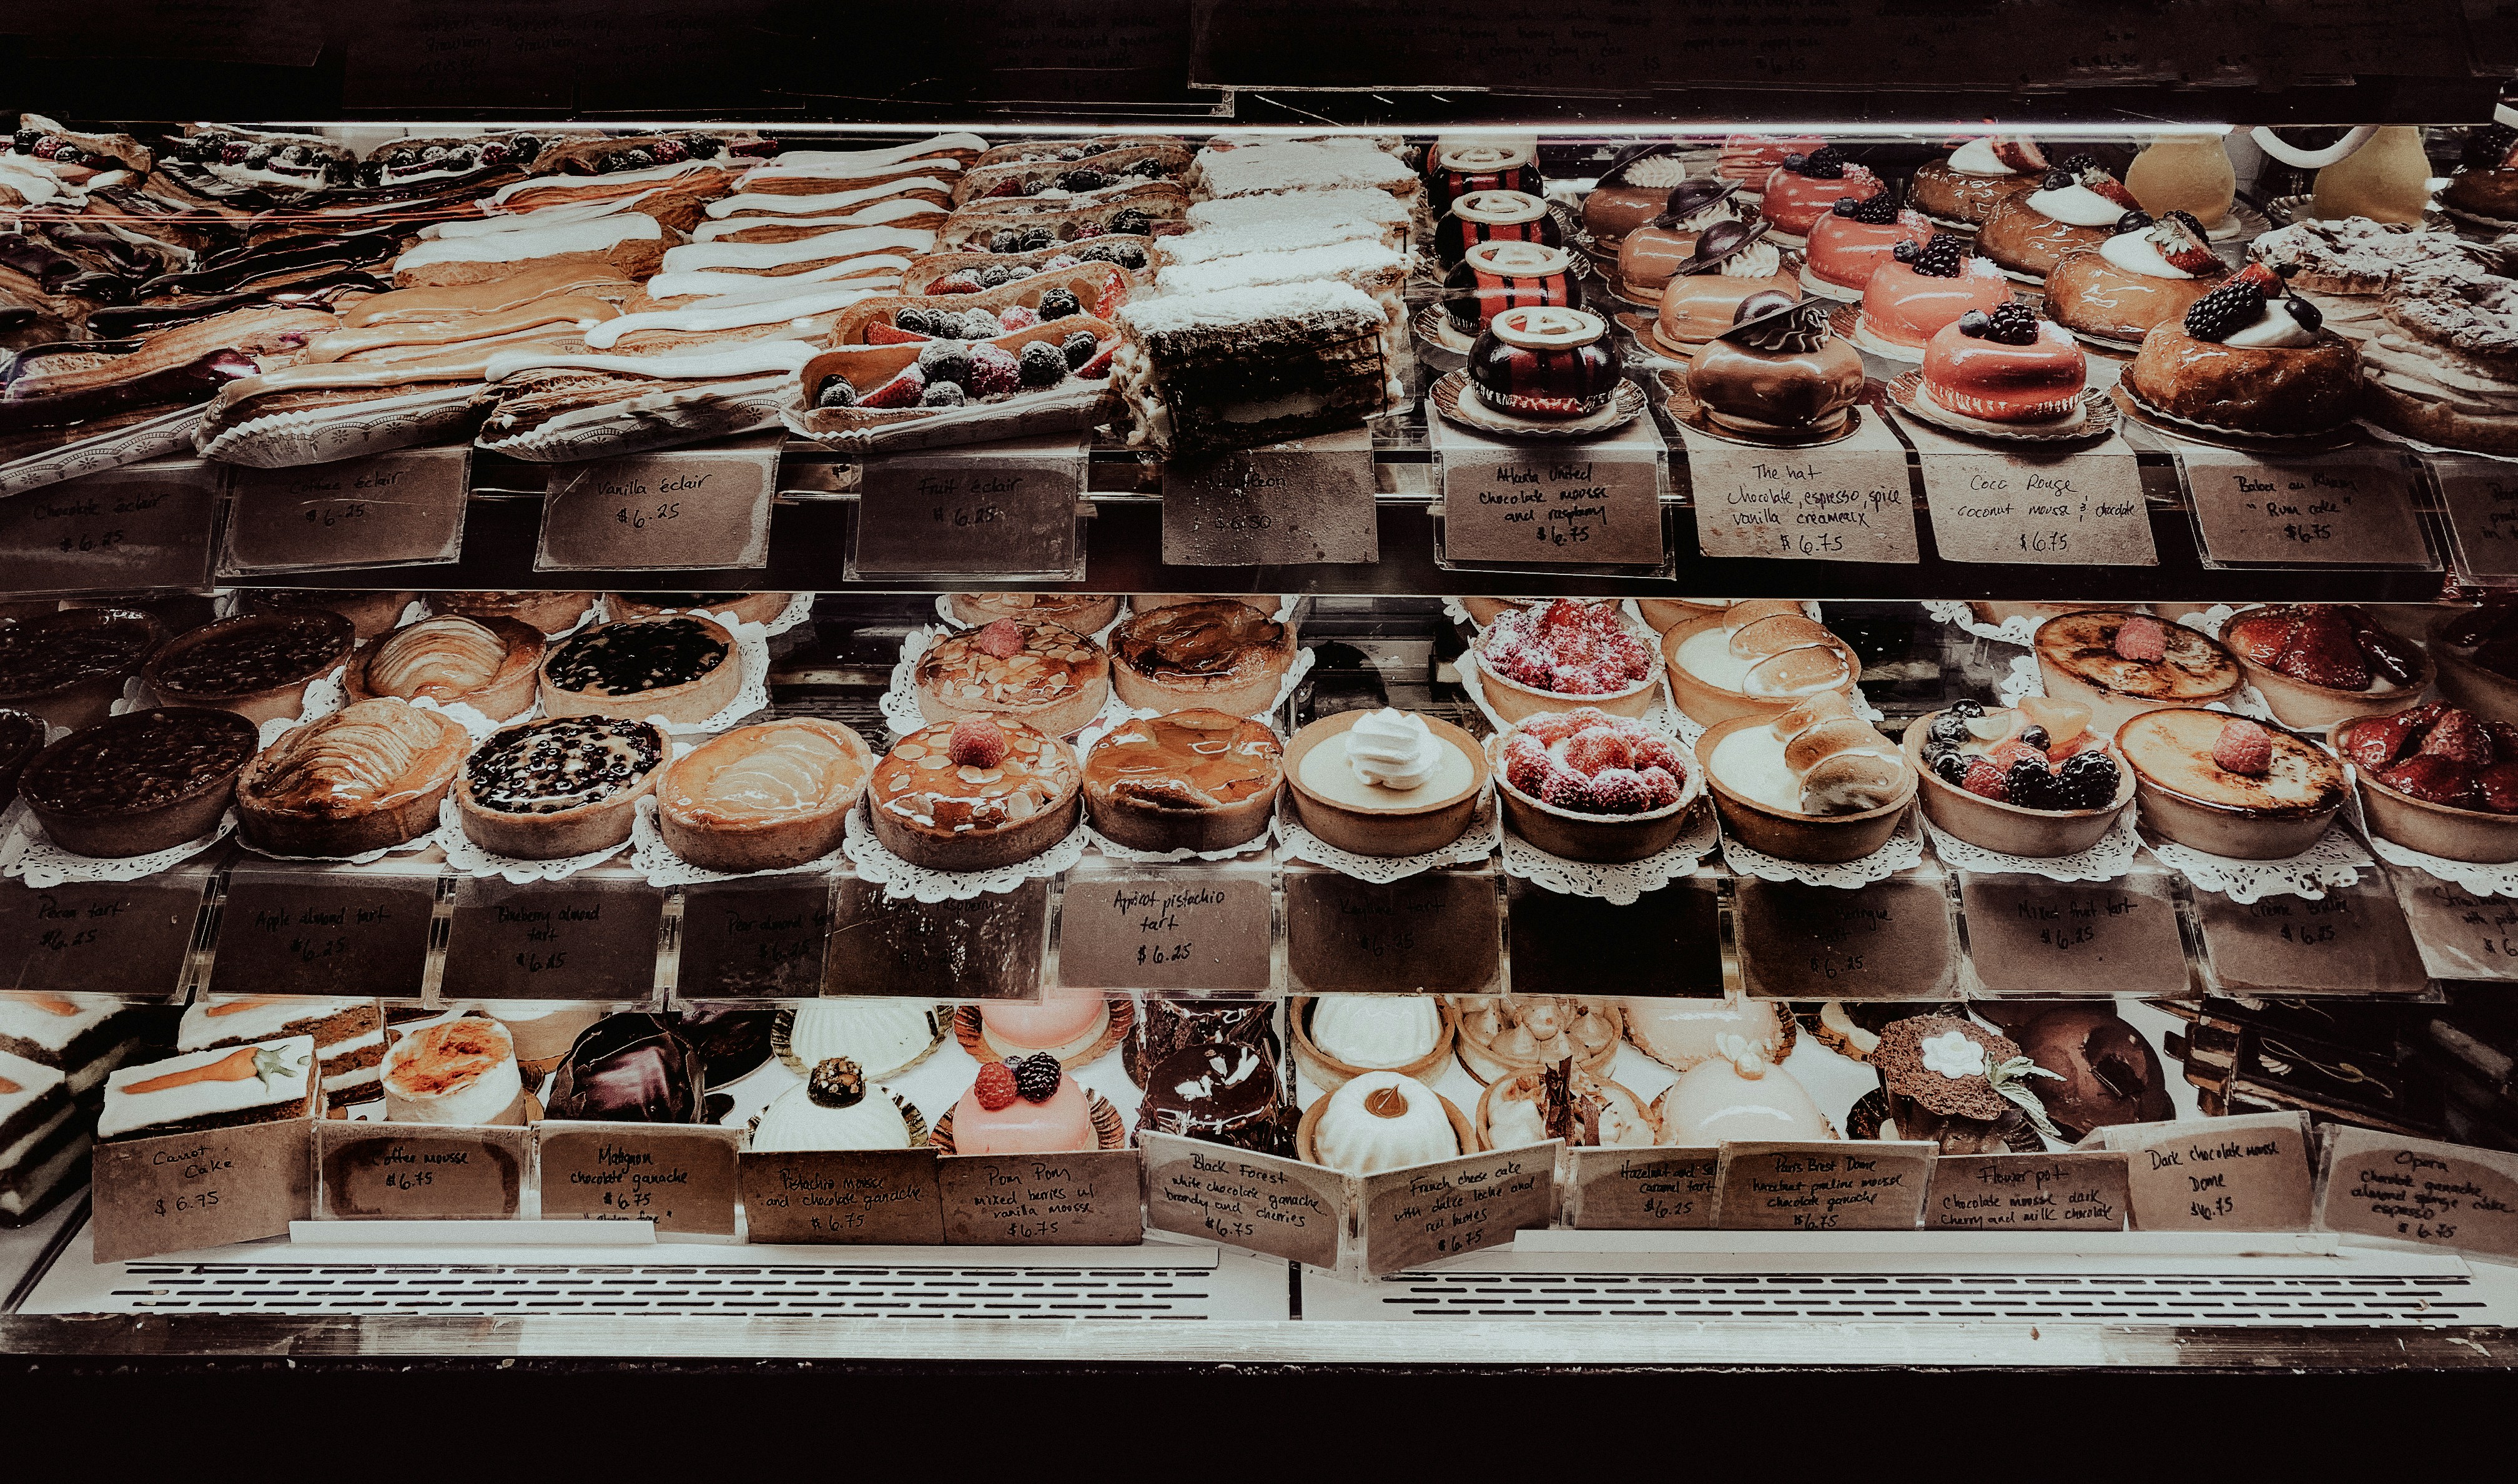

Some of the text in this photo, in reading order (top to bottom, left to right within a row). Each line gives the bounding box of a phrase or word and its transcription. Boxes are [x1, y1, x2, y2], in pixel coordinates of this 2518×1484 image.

[1497, 461, 1592, 485] Atlanta United
[1752, 463, 1822, 481] The hat
[598, 473, 713, 496] Vanilla éclair
[917, 477, 959, 496] Fruit
[2026, 473, 2079, 497] Rouge
[2233, 476, 2277, 493] Baba
[1869, 485, 1902, 513] spice
[1504, 509, 1536, 523] and
[1732, 508, 1781, 526] vanilla
[87, 902, 123, 919] tart
[558, 903, 601, 921] almond
[1113, 888, 1225, 916] Apricot pistachio
[2018, 901, 2059, 919] Mixed
[2108, 897, 2138, 916] tart
[255, 907, 290, 932] Apple
[357, 904, 392, 924] tart
[1140, 915, 1179, 932] tart
[527, 927, 559, 942] tart
[152, 1146, 211, 1166] Carrot
[423, 1152, 469, 1164] mousse
[1769, 1152, 1877, 1173] Paris Brest Dome
[2145, 1149, 2184, 1171] Dark
[2189, 1142, 2244, 1162] chocolate
[2394, 1150, 2451, 1172] Opera
[184, 1159, 234, 1178] Cake
[983, 1162, 1071, 1186] Pom Pom
[1190, 1152, 1289, 1185] Black Forest
[1410, 1161, 1521, 1197] French cheese cake
[1620, 1159, 1695, 1181] Hazelnut and
[632, 1167, 688, 1193] ganache
[779, 1168, 835, 1191] Pistachio
[1639, 1179, 1717, 1194] caramel tart
[1811, 1178, 1854, 1196] praline
[2188, 1172, 2227, 1192] Dome
[2424, 1181, 2483, 1198] ganache
[766, 1184, 922, 1211] and chocolate ganache
[974, 1183, 1095, 1206] mixed berries w/
[1172, 1175, 1328, 1217] white chocolate ganache
[1393, 1207, 1422, 1222] with
[1431, 1196, 1464, 1213] dulce
[1510, 1176, 1536, 1193] and
[1767, 1190, 1878, 1212] chocolate ganache
[2068, 1189, 2104, 1204] dark
[2351, 1183, 2406, 1201] almond
[994, 1204, 1038, 1219] vanilla
[1164, 1186, 1306, 1228] brandy and cherries
[1987, 1211, 2015, 1224] and
[2023, 1207, 2058, 1222] milk
[2065, 1203, 2113, 1221] chocolate
[2371, 1204, 2435, 1221] espresso
[1425, 1207, 1488, 1234] red berries
